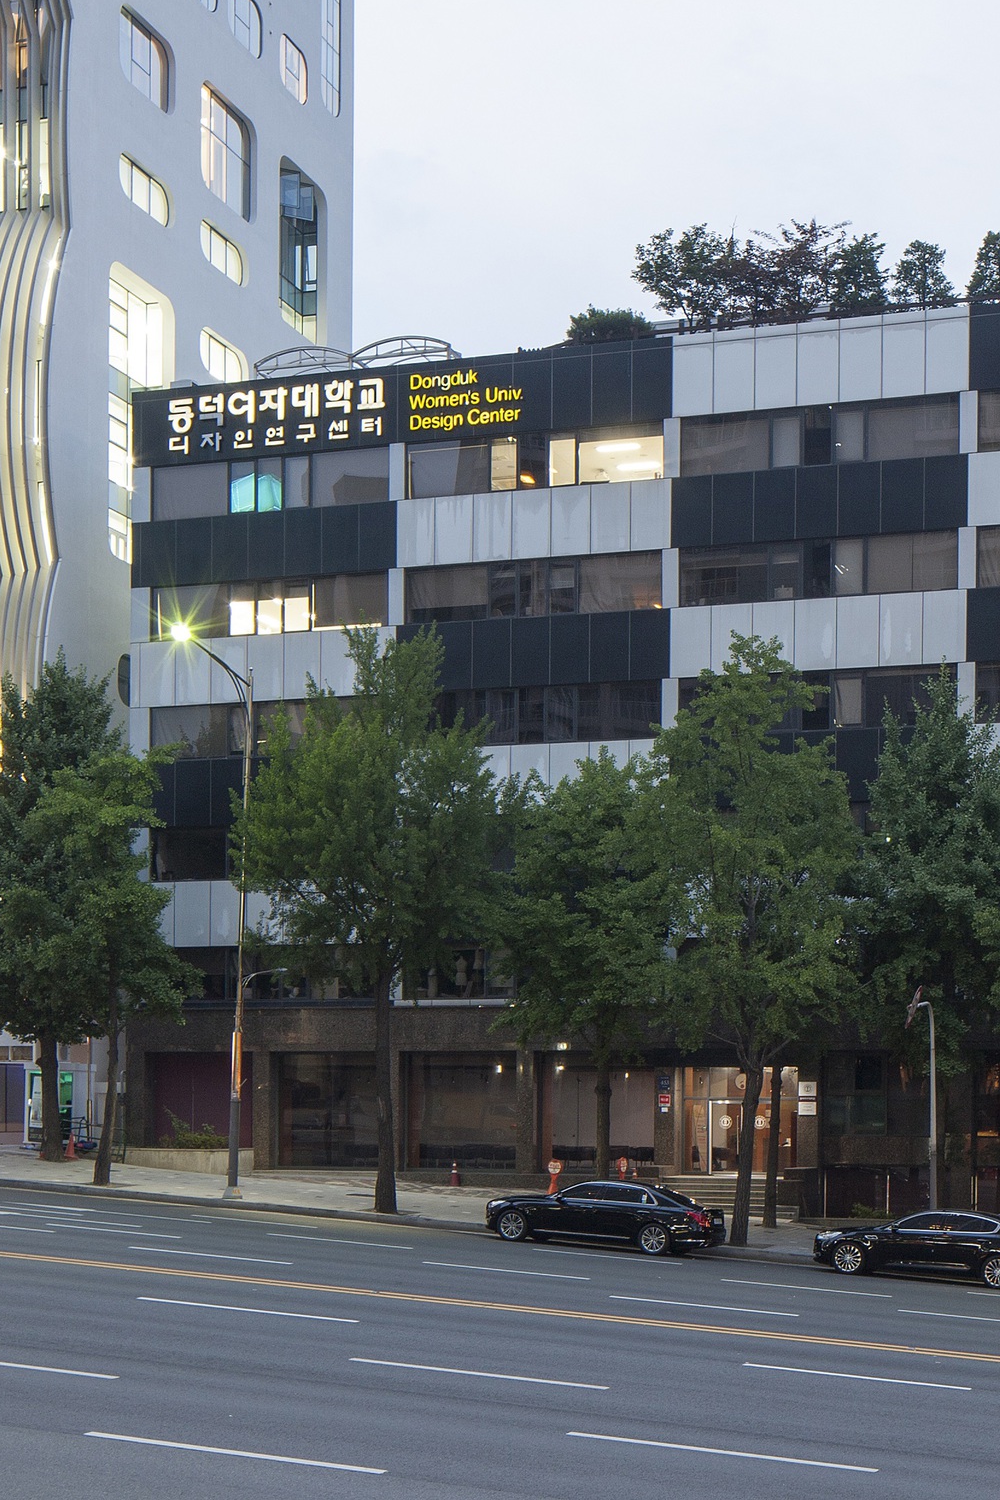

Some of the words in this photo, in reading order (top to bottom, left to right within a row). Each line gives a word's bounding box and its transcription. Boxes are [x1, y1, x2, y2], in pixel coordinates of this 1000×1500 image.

[409, 369, 478, 390] Dongduk
[168, 378, 385, 433] 동덕여자대학교
[409, 390, 480, 410] Women's
[485, 386, 523, 403] Univ.
[409, 413, 463, 431] Design
[467, 408, 521, 425] Center
